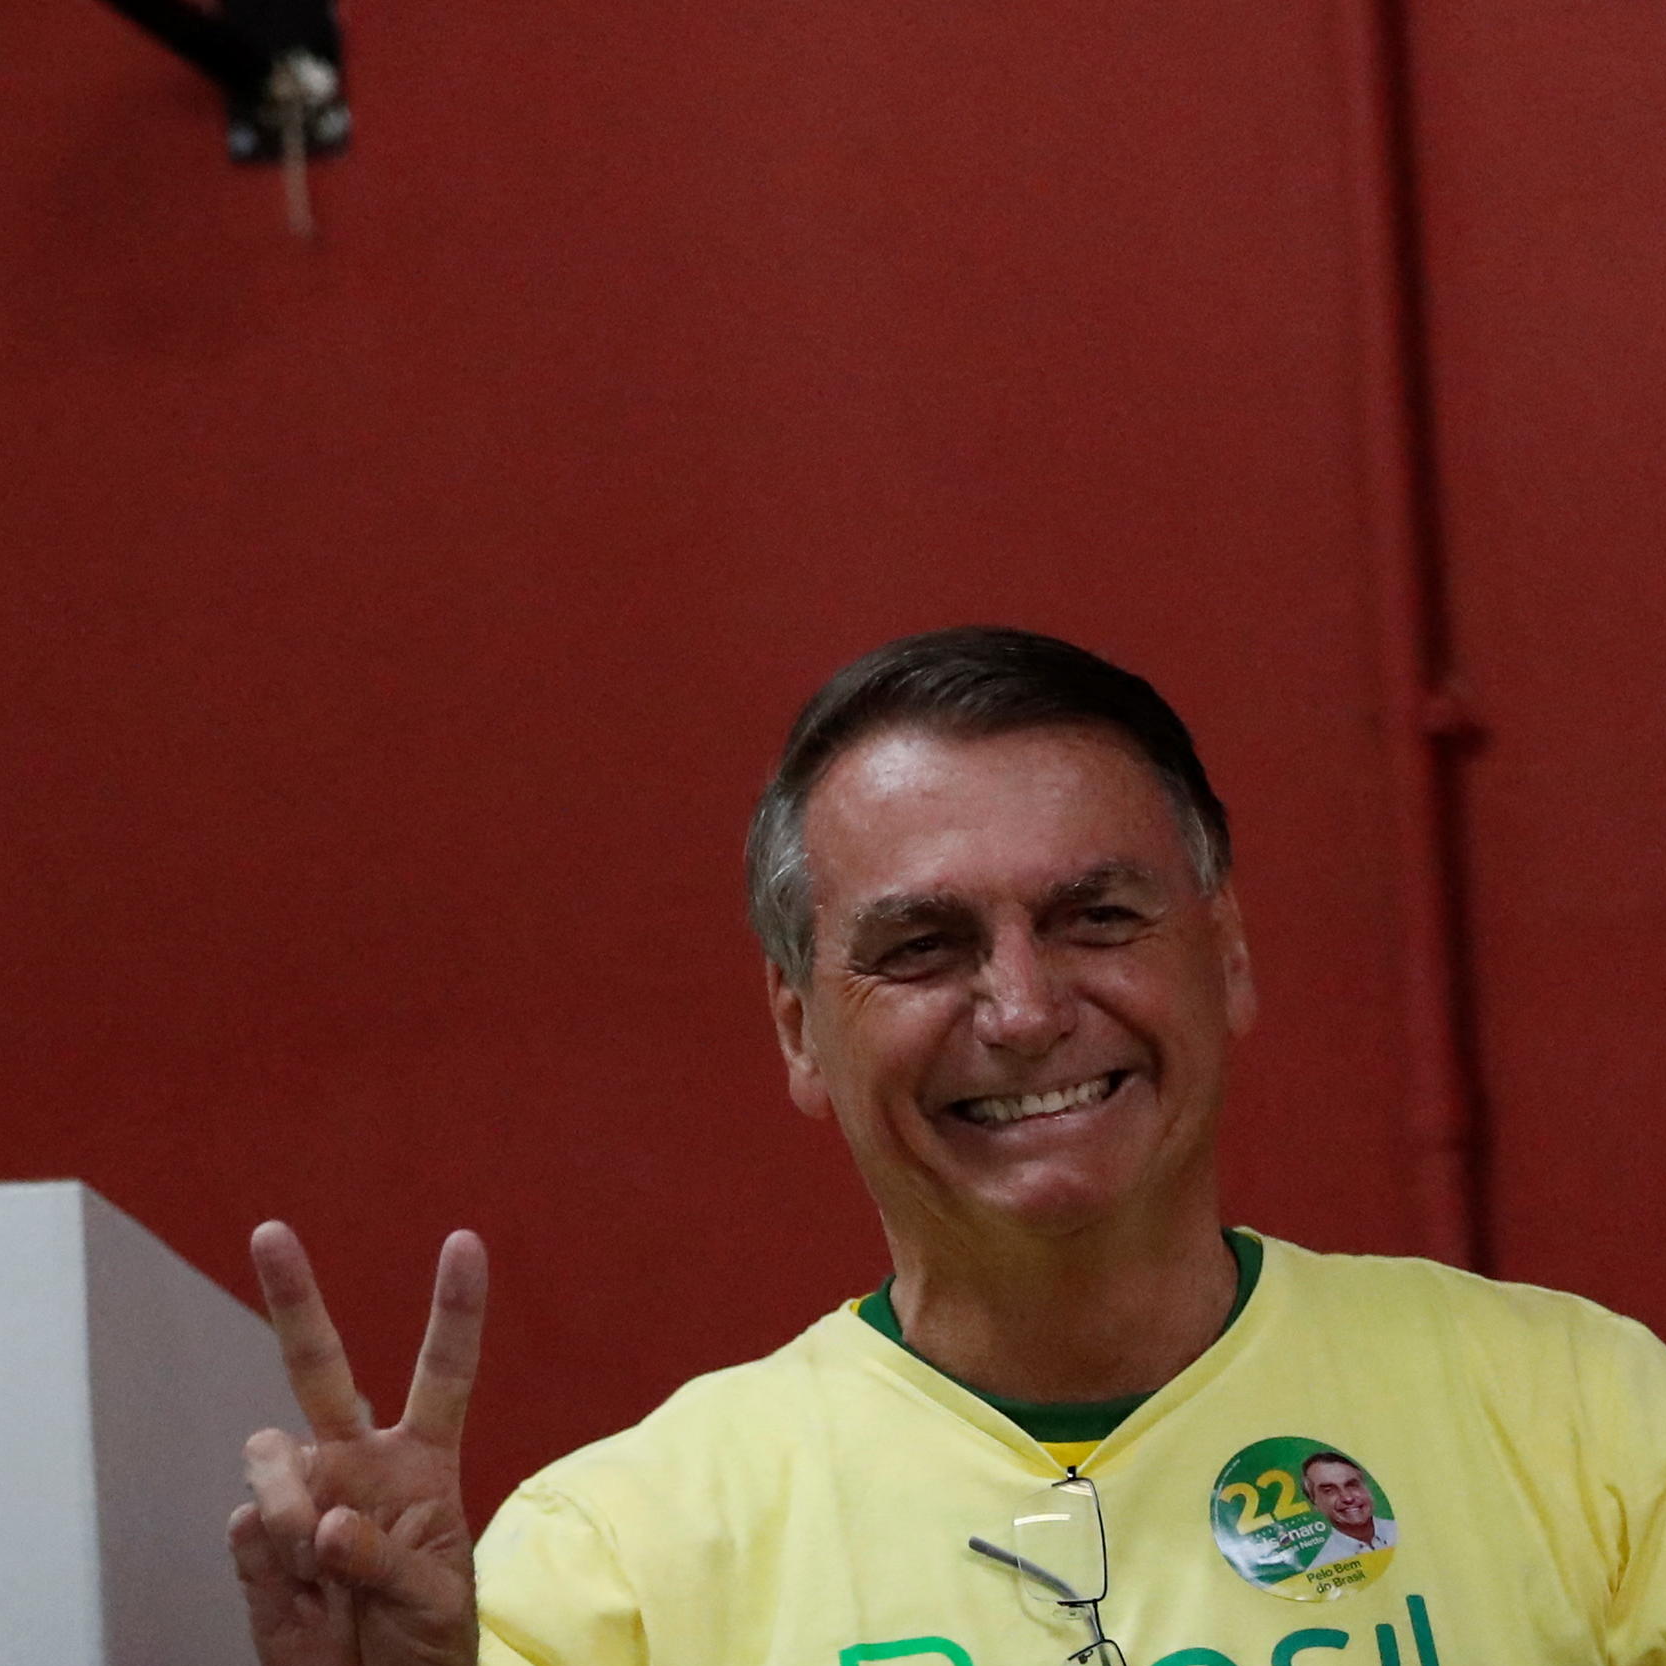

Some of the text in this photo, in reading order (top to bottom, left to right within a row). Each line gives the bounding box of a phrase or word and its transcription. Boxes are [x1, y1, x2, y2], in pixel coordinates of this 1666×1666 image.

[1219, 1469, 1311, 1536] 22
[1306, 1558, 1362, 1583] Pelo Bem
[1316, 1570, 1366, 1595] do Brasil
